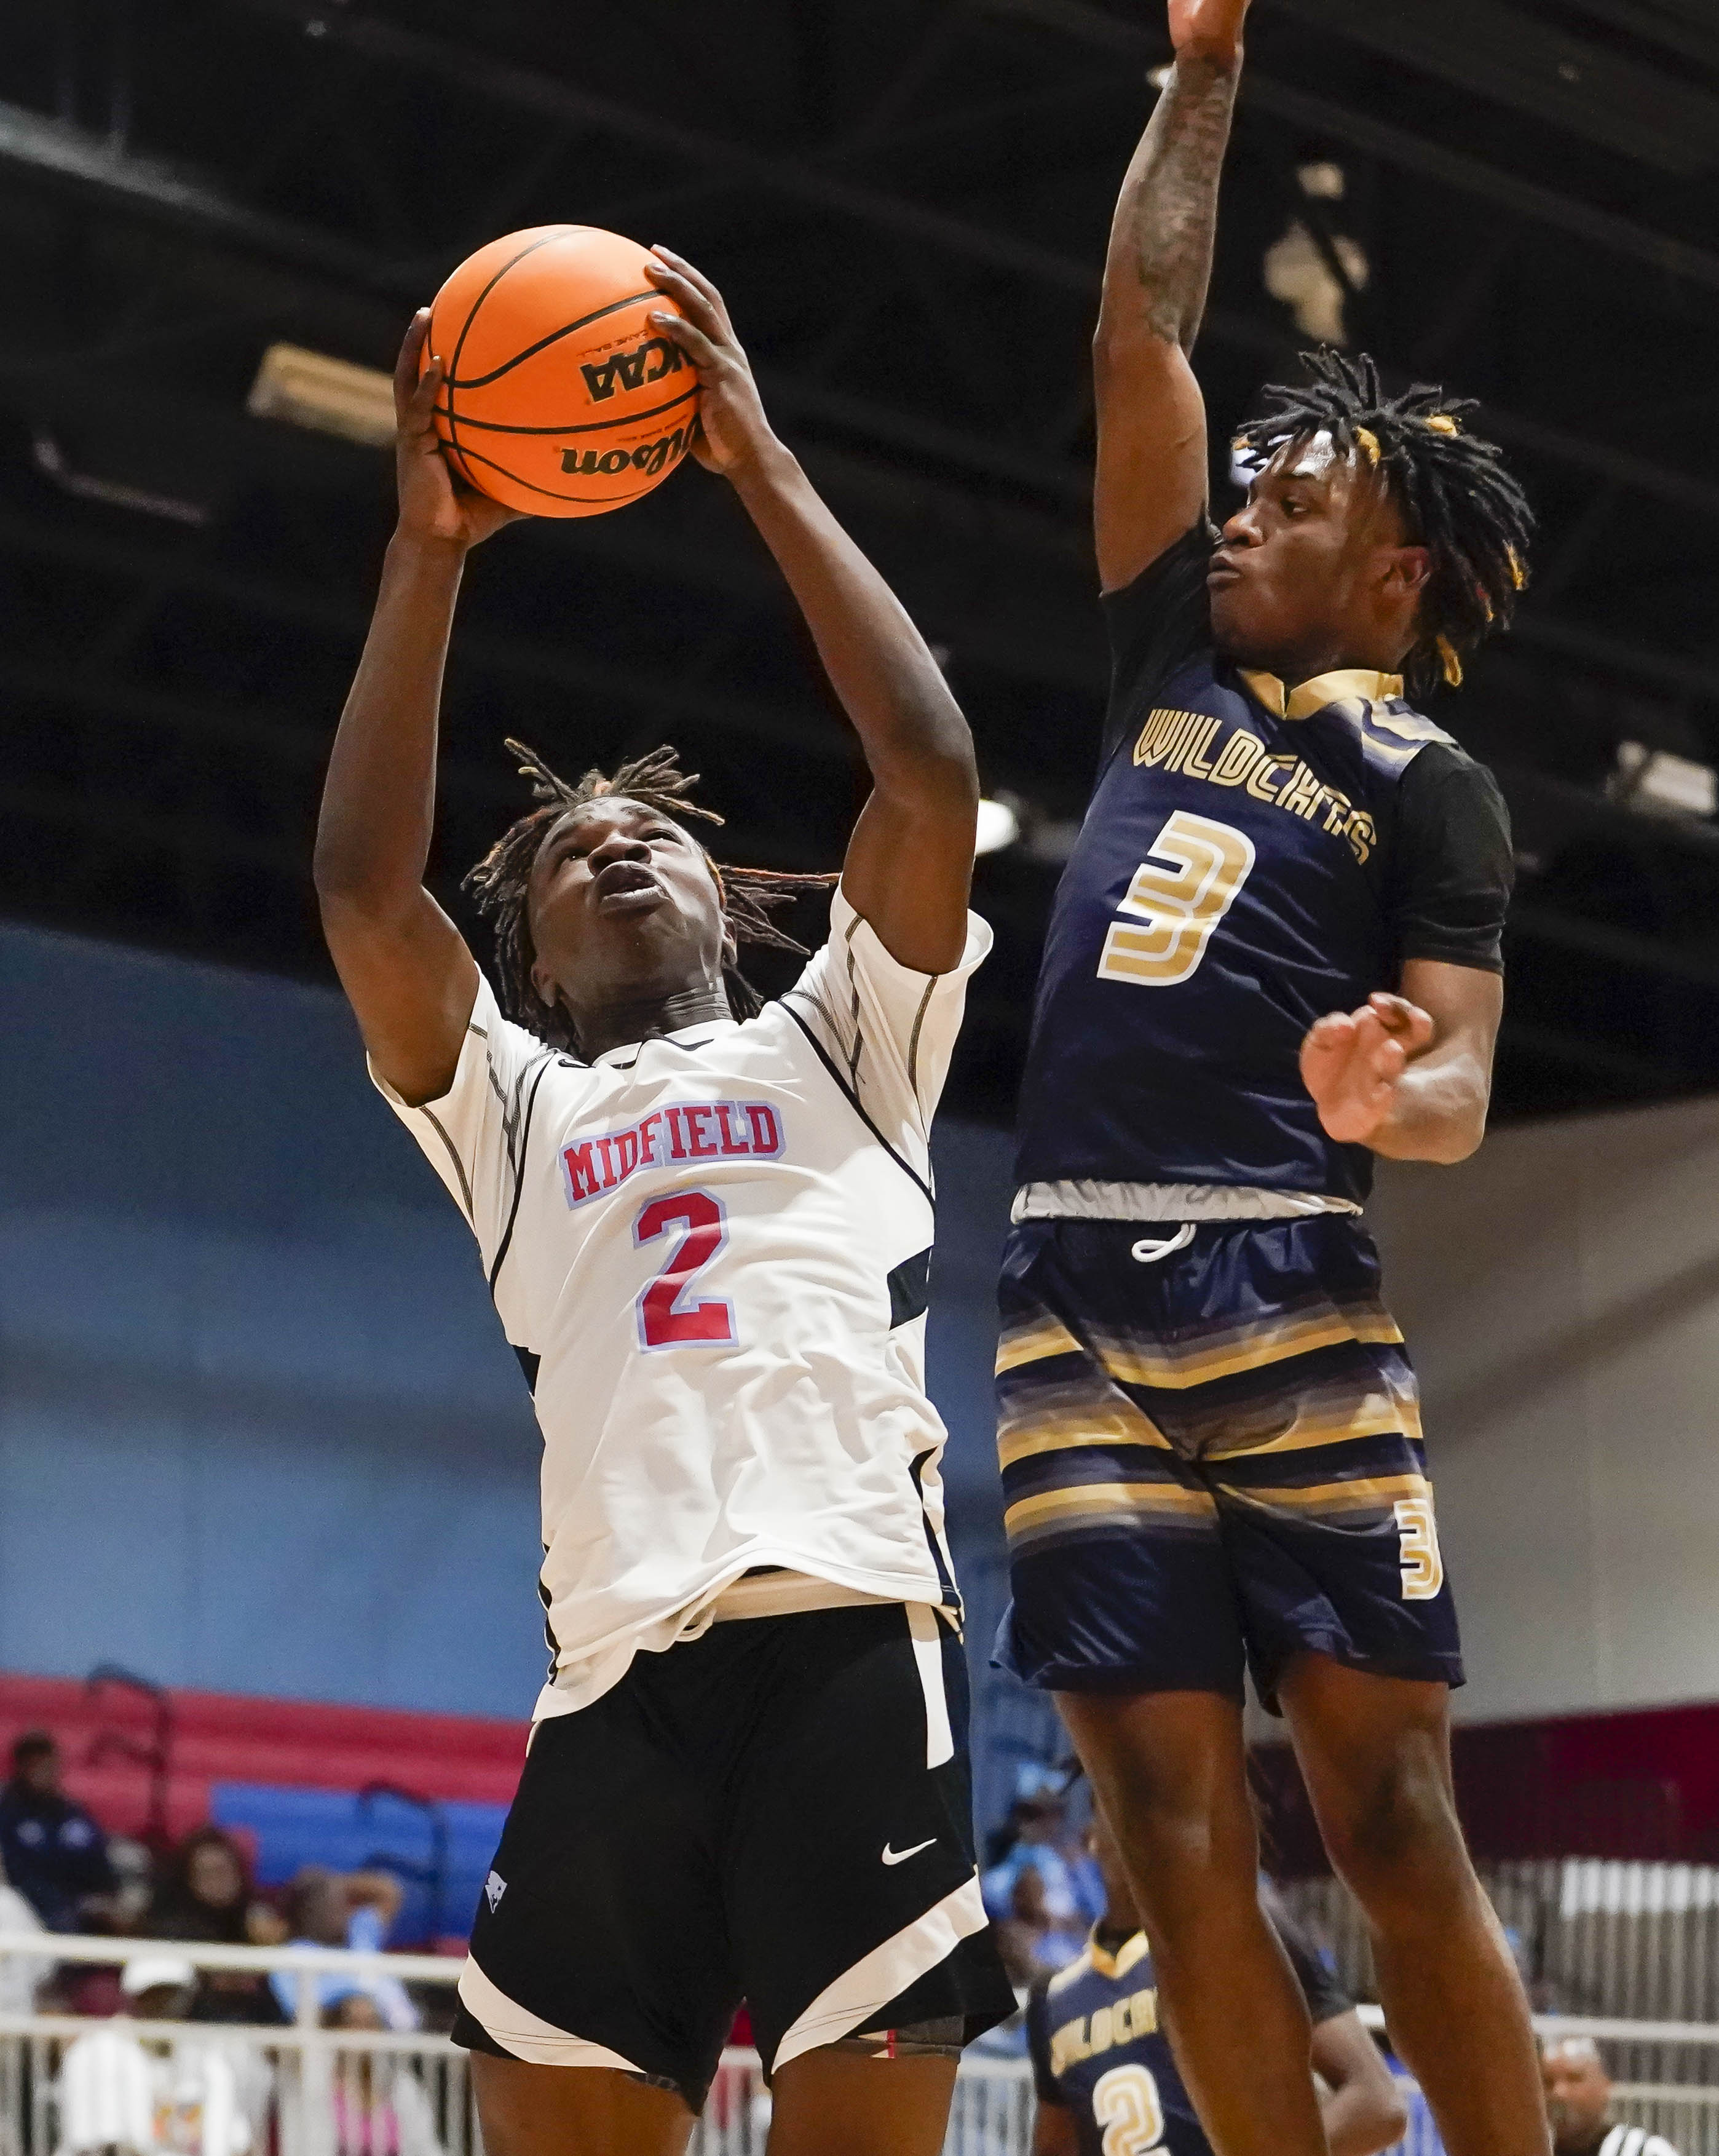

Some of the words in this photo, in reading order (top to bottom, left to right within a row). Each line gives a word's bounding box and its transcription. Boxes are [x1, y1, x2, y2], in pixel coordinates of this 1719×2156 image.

[1133, 708, 1377, 865] WILDCATS
[1097, 810, 1255, 986] 3
[561, 1102, 784, 1207] MIDFIELD
[633, 1187, 738, 1352] 2
[1393, 1498, 1444, 1599] 3
[1093, 2063, 1172, 2156] 2
